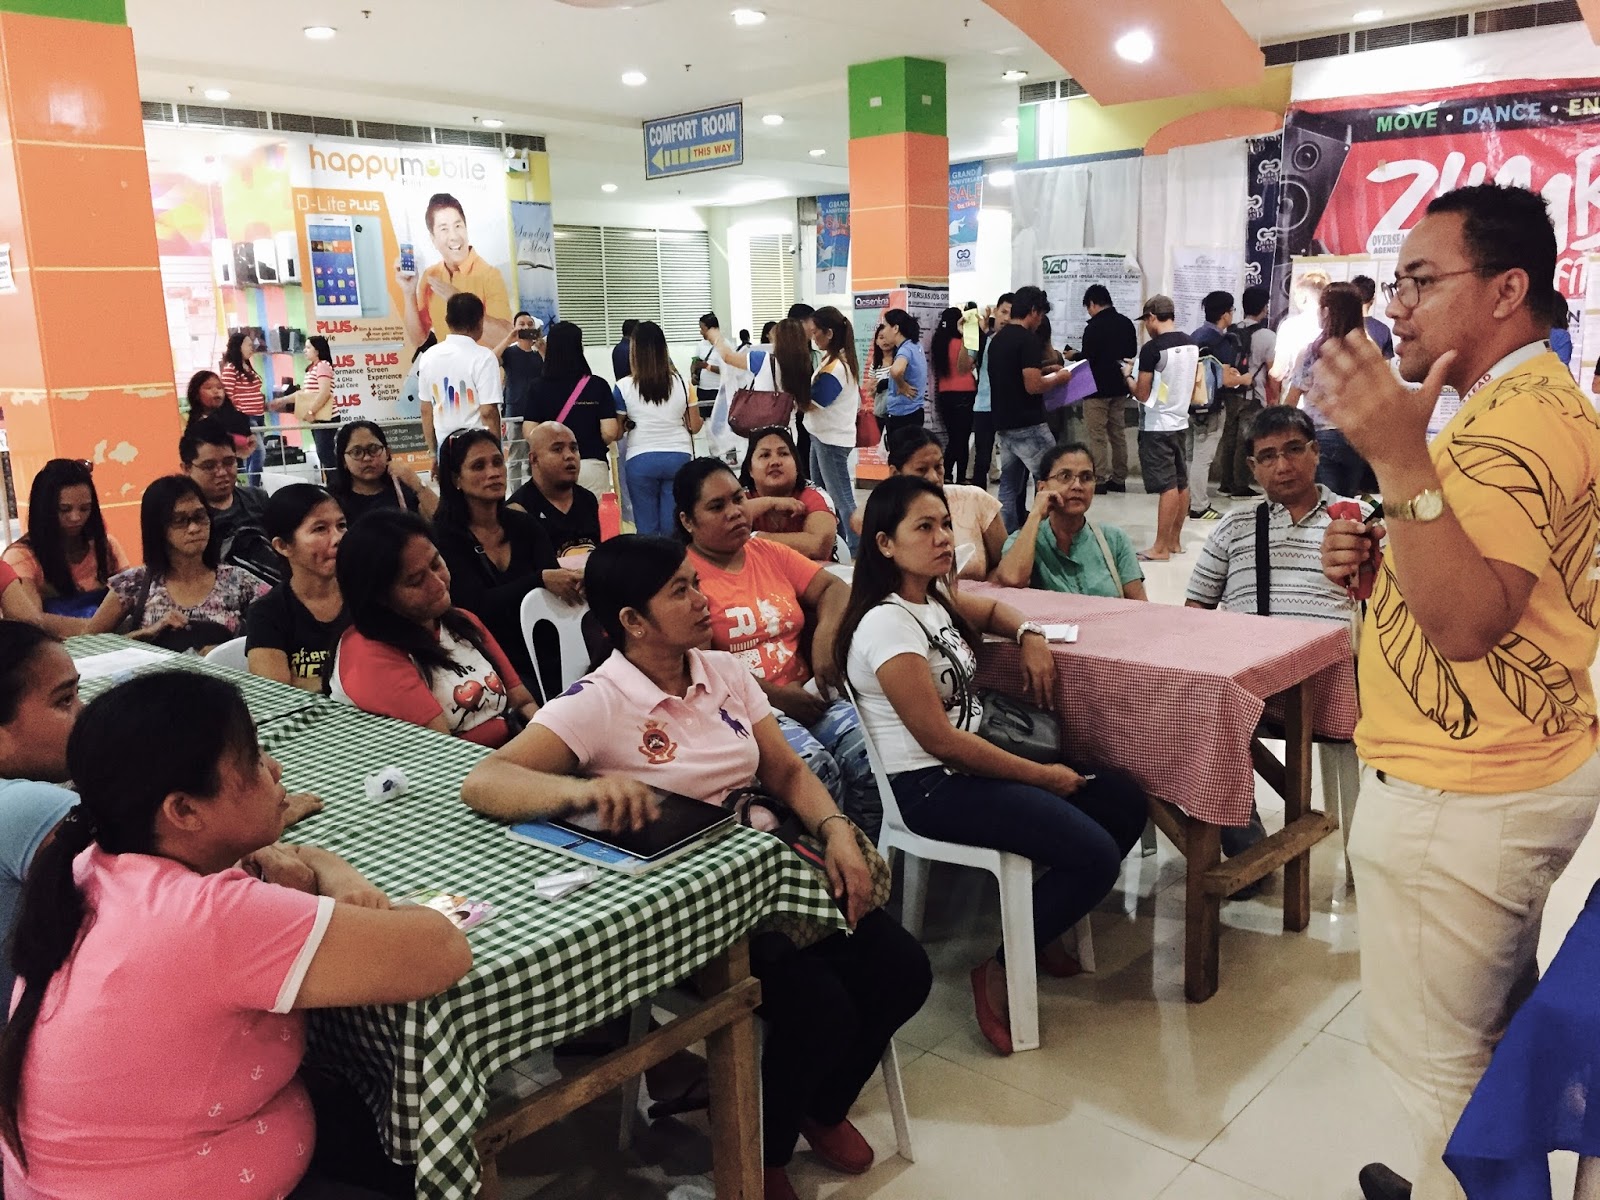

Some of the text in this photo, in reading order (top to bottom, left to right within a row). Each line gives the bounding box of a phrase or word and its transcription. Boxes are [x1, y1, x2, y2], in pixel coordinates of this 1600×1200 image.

[1376, 111, 1438, 132] MOVE
[1462, 102, 1542, 125] DANCE
[649, 111, 736, 146] COMFORT ROOM
[693, 143, 732, 158] THIS WAY
[951, 169, 976, 179] GRAND
[949, 183, 982, 202] SALE
[350, 198, 381, 212] PLUS
[517, 226, 551, 244] Sunday
[316, 320, 353, 334] PLUS
[365, 353, 399, 366] PLUS
[367, 373, 402, 381] Experience
[333, 393, 361, 407] LUS
